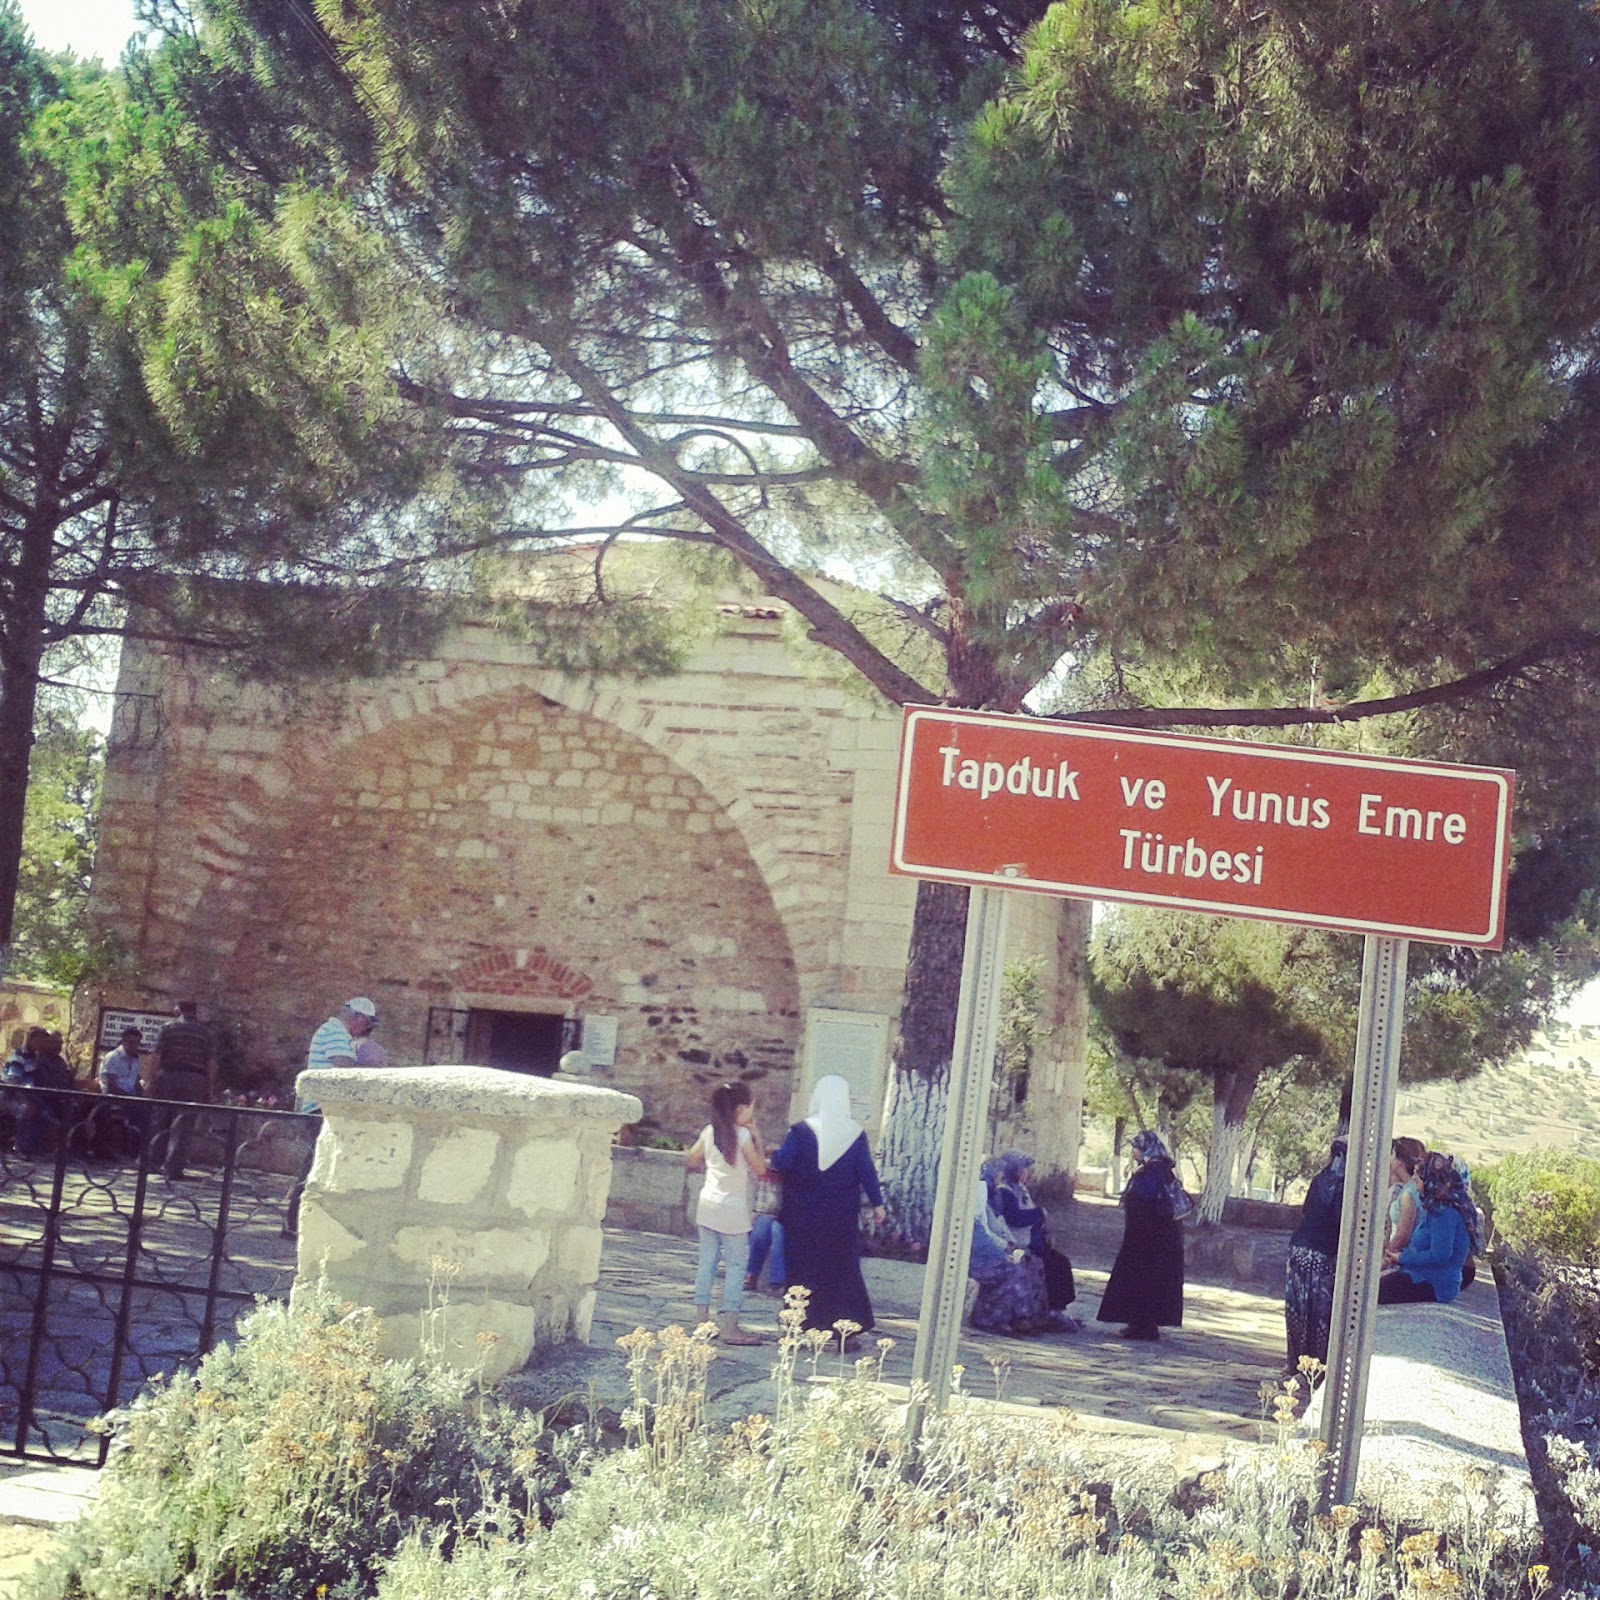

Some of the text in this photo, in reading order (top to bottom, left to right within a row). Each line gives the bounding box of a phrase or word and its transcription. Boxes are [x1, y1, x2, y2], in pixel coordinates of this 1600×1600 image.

[938, 746, 1468, 846] Tapduk ve Yunus Emre
[1118, 828, 1265, 887] Türbesi
